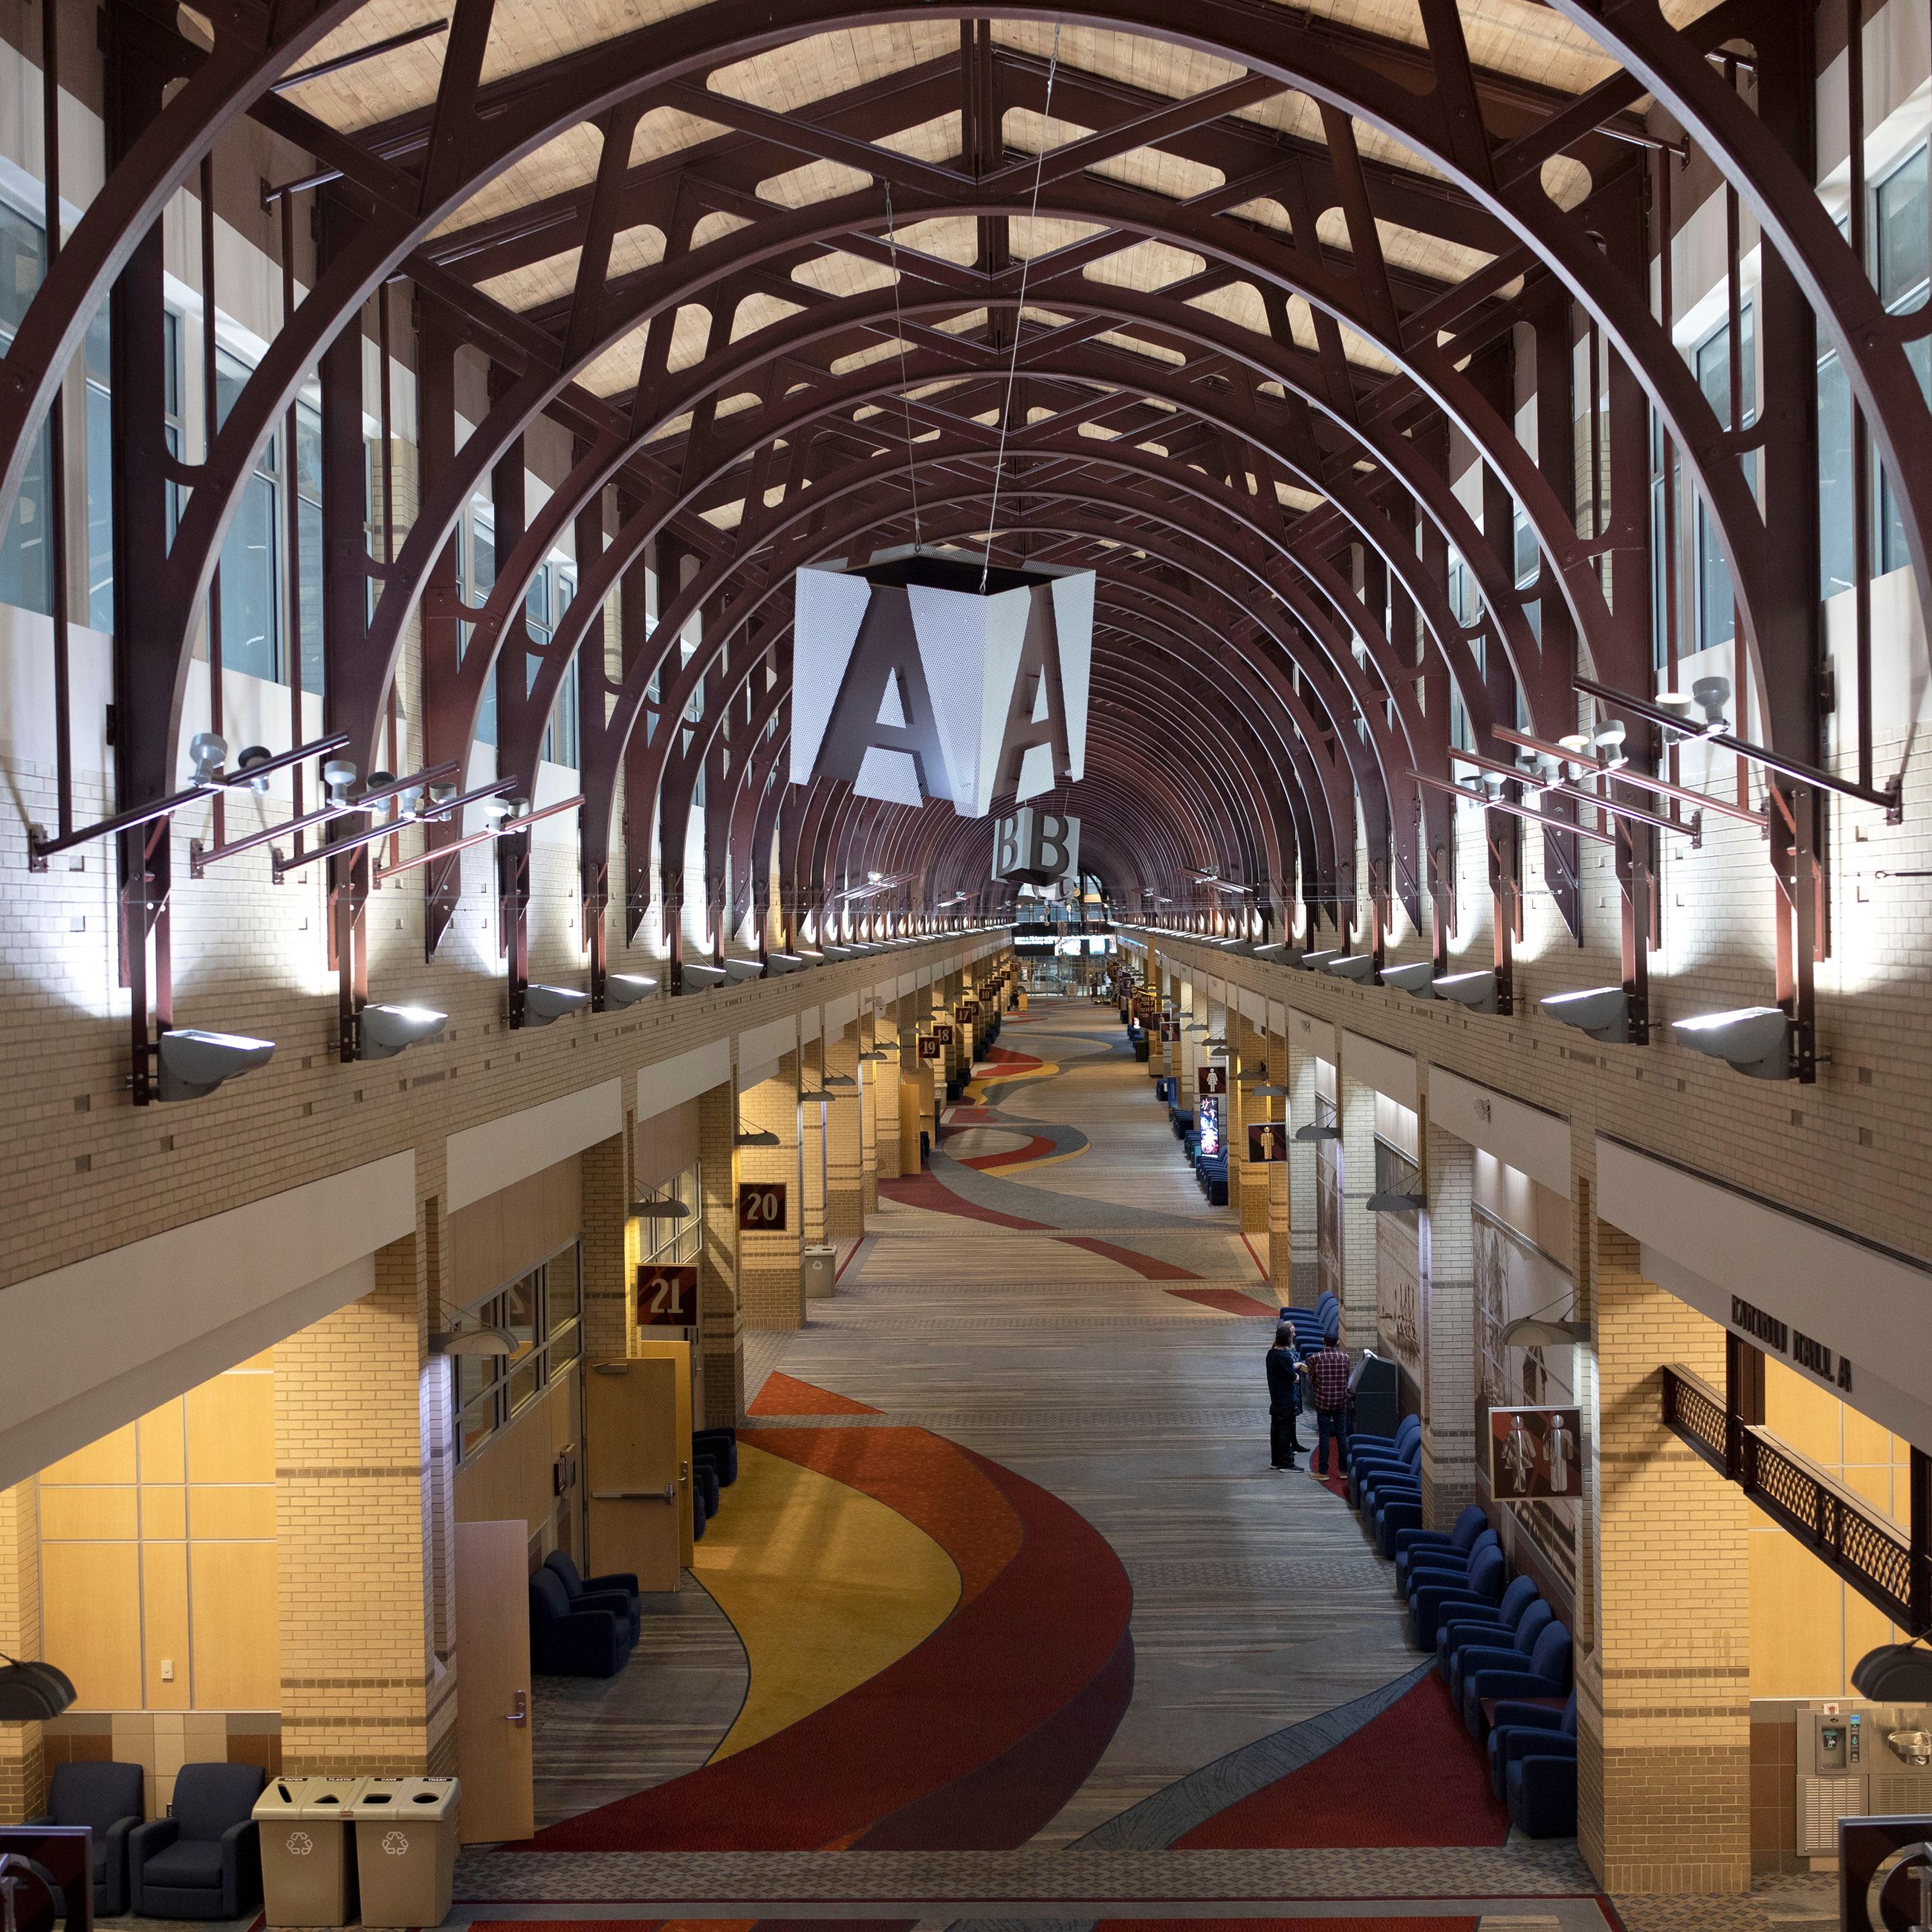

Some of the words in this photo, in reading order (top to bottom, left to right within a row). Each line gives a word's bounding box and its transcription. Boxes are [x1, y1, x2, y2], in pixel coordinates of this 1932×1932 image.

[811, 584, 956, 804] A
[990, 582, 1072, 797] A
[996, 812, 1019, 878] B
[1029, 811, 1070, 876] B
[938, 1028, 949, 1041] 18
[959, 1011, 969, 1021] 17
[923, 1041, 936, 1054] 19
[746, 1193, 778, 1221] 20
[649, 1278, 684, 1314] 21
[1837, 1355, 1852, 1393] A
